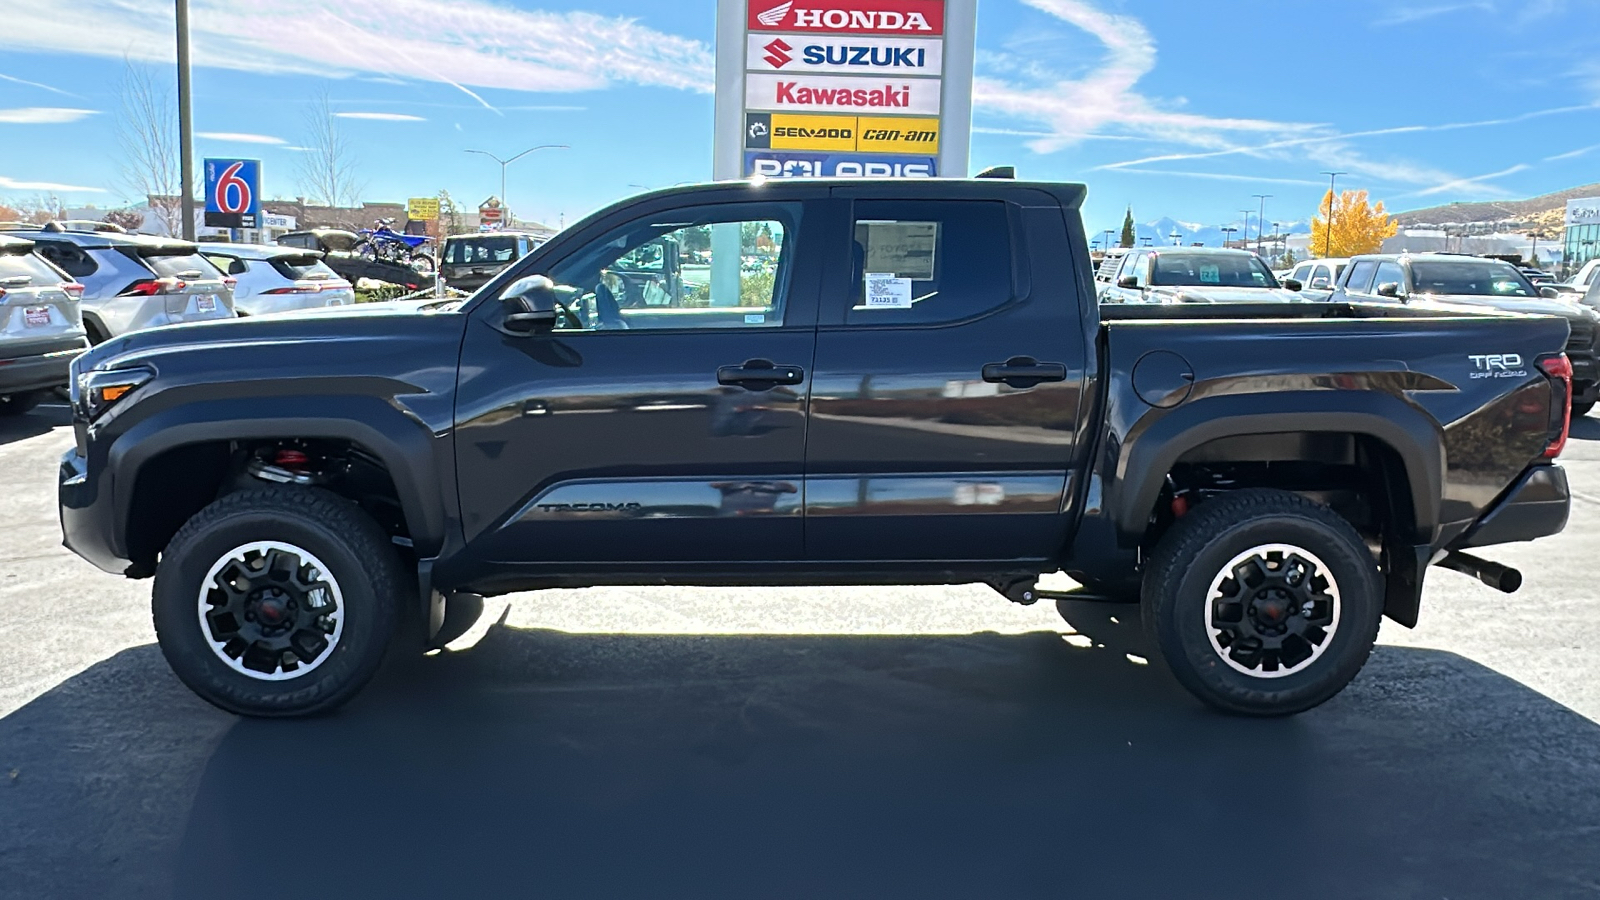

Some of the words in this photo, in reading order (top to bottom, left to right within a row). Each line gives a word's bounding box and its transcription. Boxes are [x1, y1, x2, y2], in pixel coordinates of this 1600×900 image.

[794, 8, 932, 31] HONDA
[803, 45, 925, 67] SUZUKI
[776, 82, 909, 107] Kawasaki
[754, 159, 930, 178] POLARIS
[215, 161, 251, 213] 6
[1468, 354, 1524, 370] TRD
[537, 502, 642, 512] TACOMA
